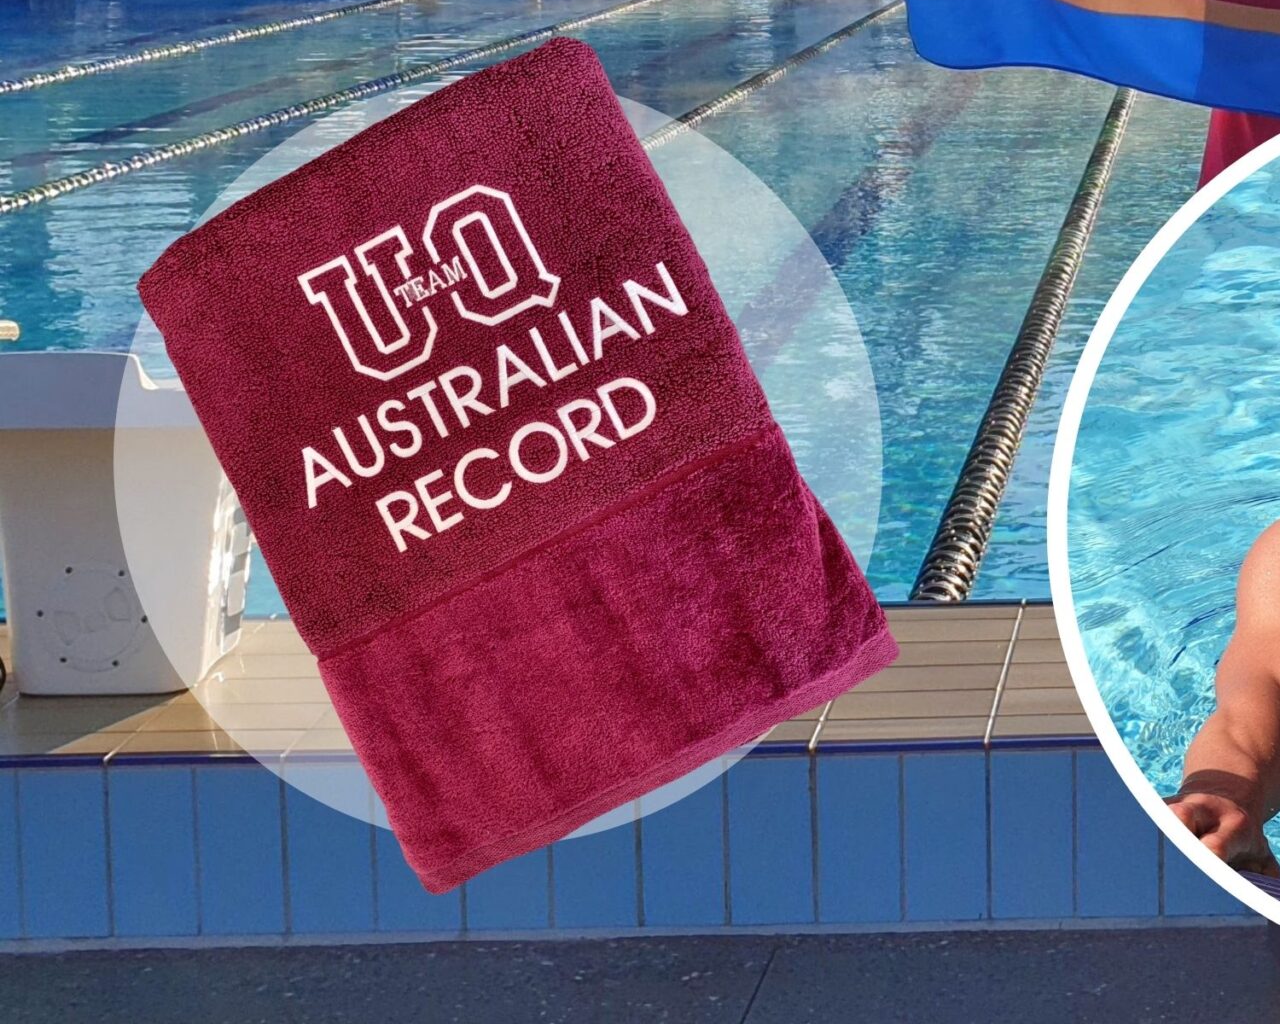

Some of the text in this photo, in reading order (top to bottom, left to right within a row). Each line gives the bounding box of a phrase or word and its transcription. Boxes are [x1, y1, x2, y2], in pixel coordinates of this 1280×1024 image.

[297, 184, 562, 382] UQ
[393, 256, 469, 309] TEAM
[301, 261, 690, 509] AUSTRALIAN
[375, 377, 657, 554] RECORD
